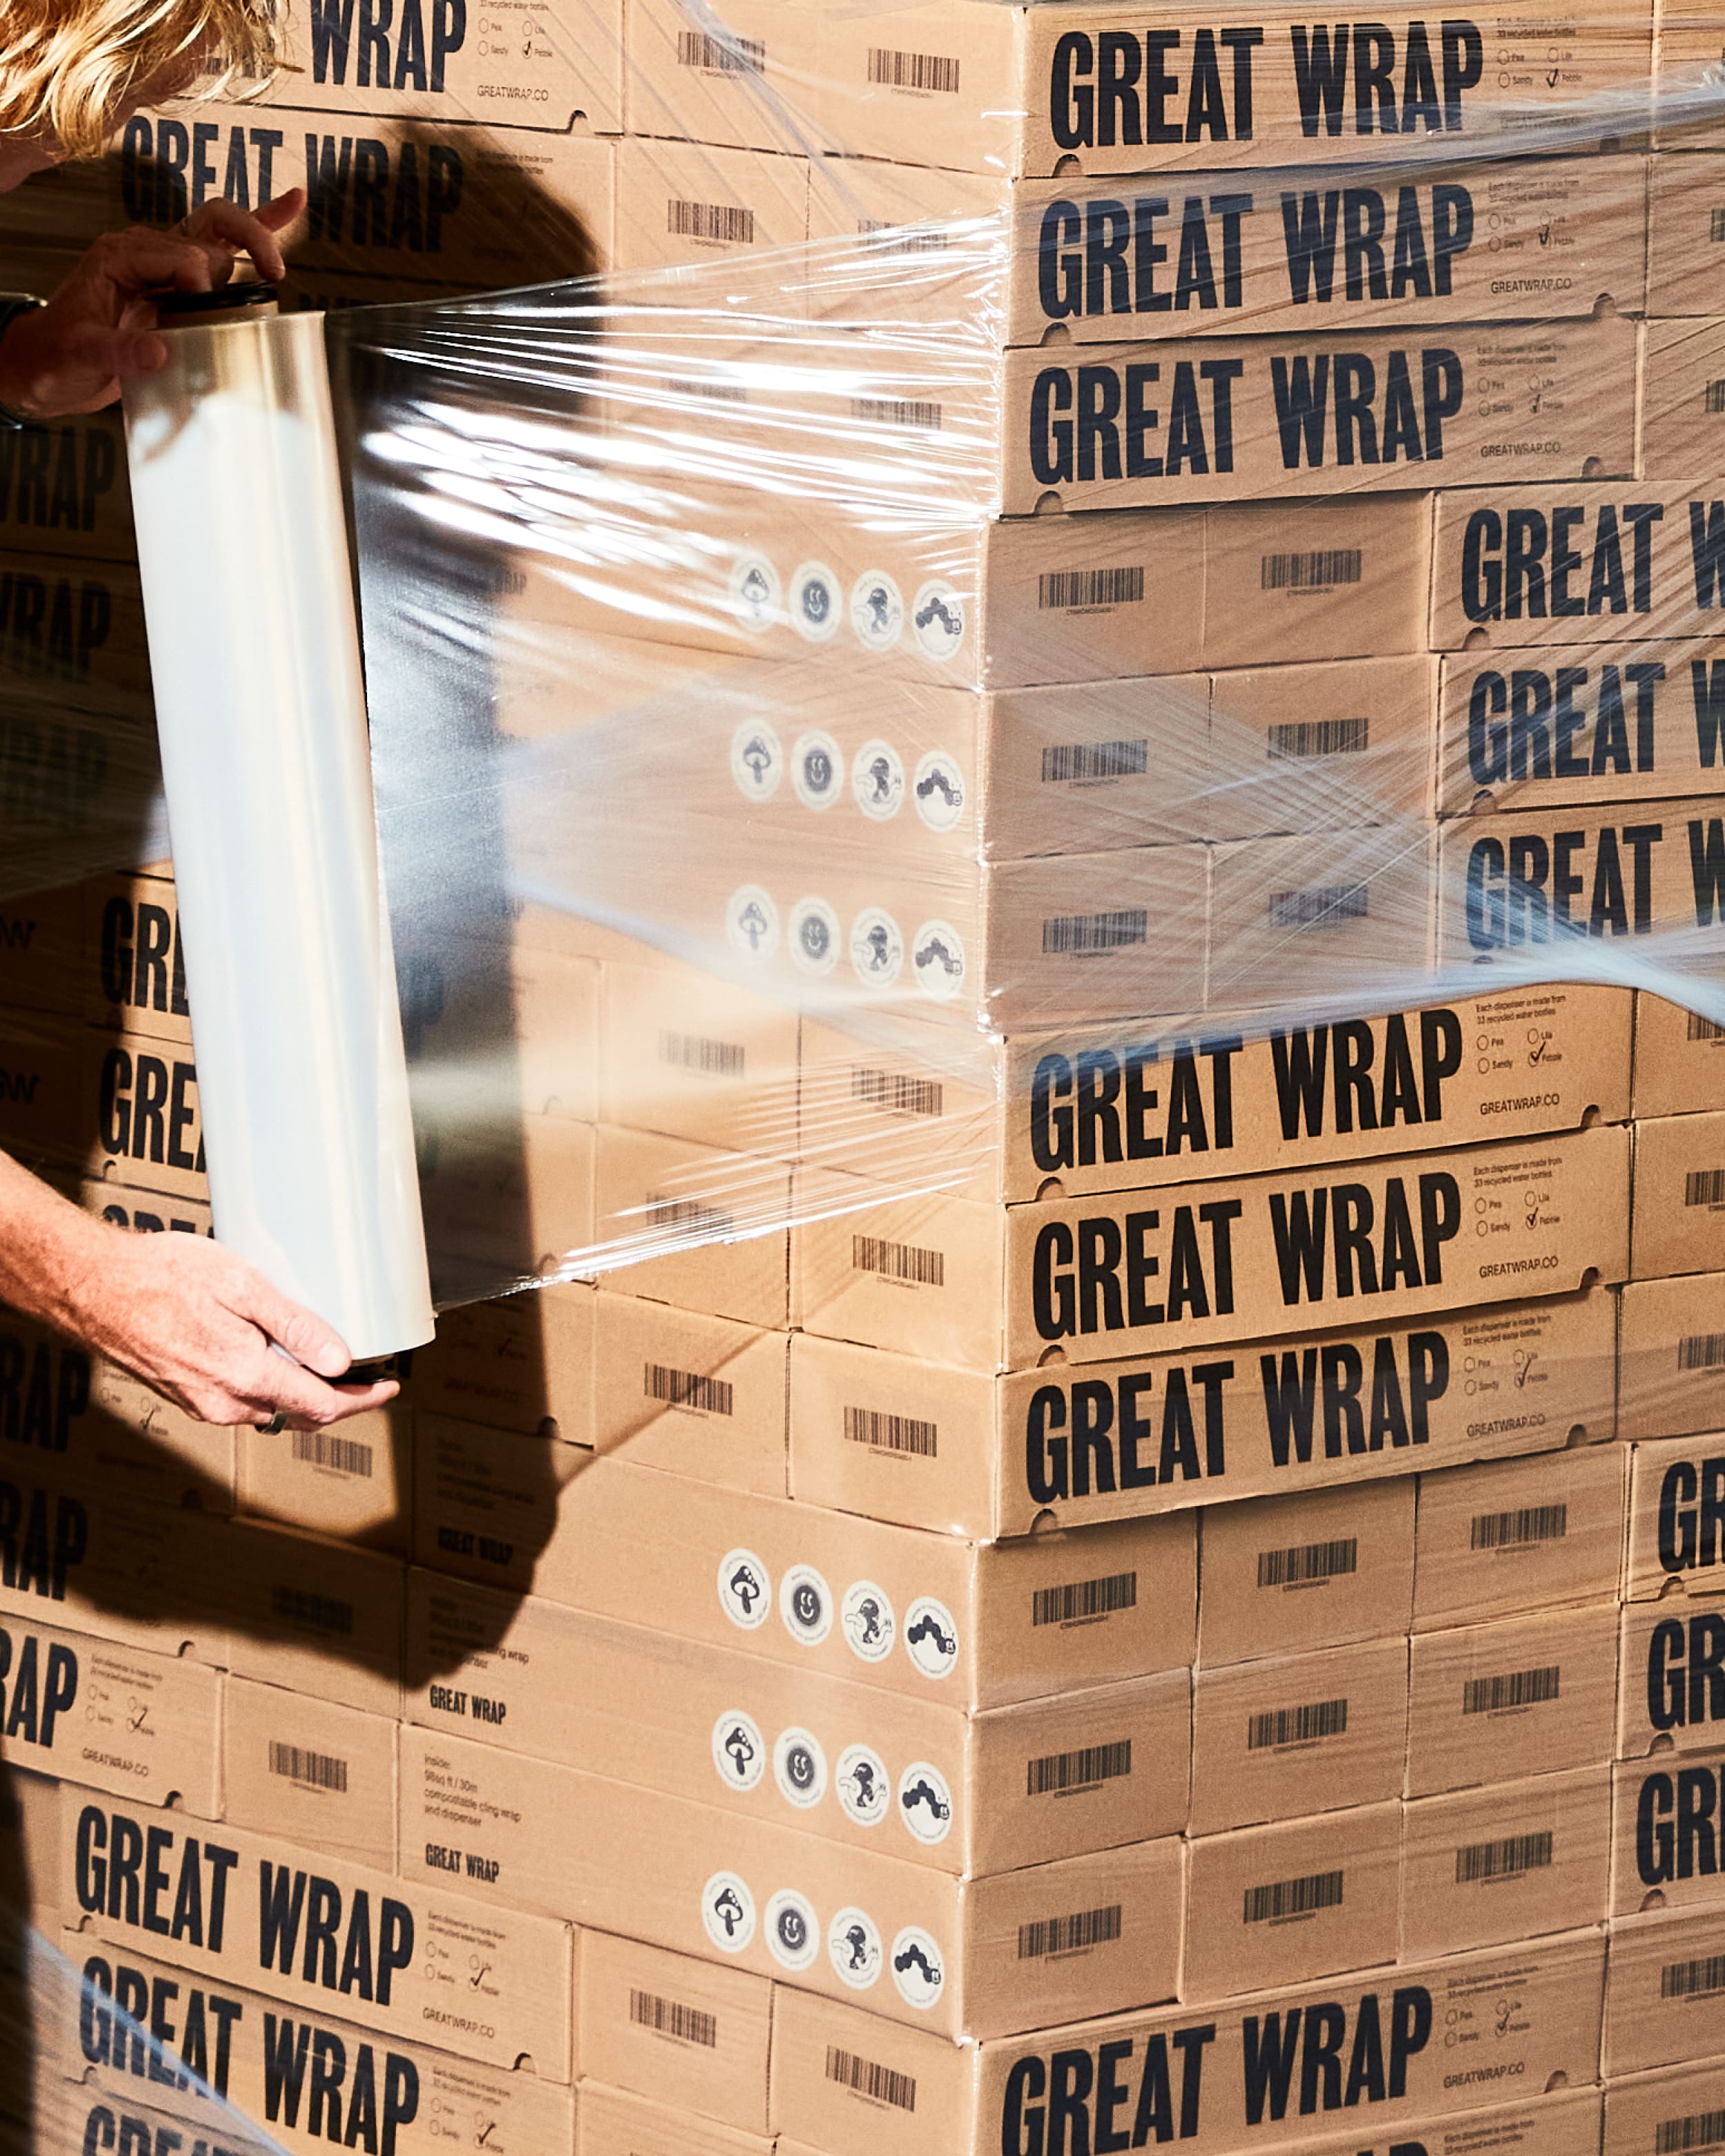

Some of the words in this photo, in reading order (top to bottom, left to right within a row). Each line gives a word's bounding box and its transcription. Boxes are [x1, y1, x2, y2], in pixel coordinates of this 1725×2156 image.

[310, 0, 467, 92] WRAP
[477, 85, 549, 101] GREATWRAP.CO
[1049, 26, 1263, 150] GREAT
[1290, 20, 1483, 137] WRAP
[121, 115, 283, 224] GREAT
[306, 132, 464, 253] WRAP
[1038, 192, 1252, 319] GREAT
[1280, 184, 1474, 304] WRAP
[1491, 278, 1572, 294] GREATWRAP.CO
[1029, 357, 1243, 484] GREAT
[1270, 348, 1463, 468] WRAP
[1481, 442, 1559, 457] GREATWRAP.CO
[1461, 503, 1664, 622] GREAT
[1467, 662, 1666, 784] GREAT
[1466, 823, 1663, 951] GREAT
[100, 1048, 206, 1173] GRE
[1031, 1039, 1243, 1172] GREAT
[1270, 1008, 1462, 1140] WRAP
[1480, 1093, 1559, 1115] GREATWRAP.CO
[1032, 1199, 1242, 1341] GREAT
[1268, 1171, 1461, 1306] WRAP
[1479, 1256, 1558, 1278] GREATWRAP.CO
[1026, 1361, 1234, 1504] GREAT
[1260, 1331, 1449, 1467] WRAP
[1467, 1414, 1546, 1436] GREATWRAP.CO
[429, 1684, 467, 1715] GREAT
[472, 1695, 506, 1725] WRAP
[424, 1789, 477, 1810] compostable
[501, 1810, 521, 1823] wrap
[426, 1843, 462, 1873] GREAT
[466, 1854, 499, 1883] WRAP
[75, 1806, 238, 1953] GREAT
[259, 1860, 414, 2006] WRAP
[80, 1955, 242, 2100] GREAT
[264, 2012, 420, 2156] WRAP
[423, 2007, 495, 2038] GREATWRAP.CO
[1001, 2024, 1216, 2156] GREAT
[1242, 1985, 1432, 2126] WRAP
[1443, 2061, 1525, 2088] GREATWRAP.CO
